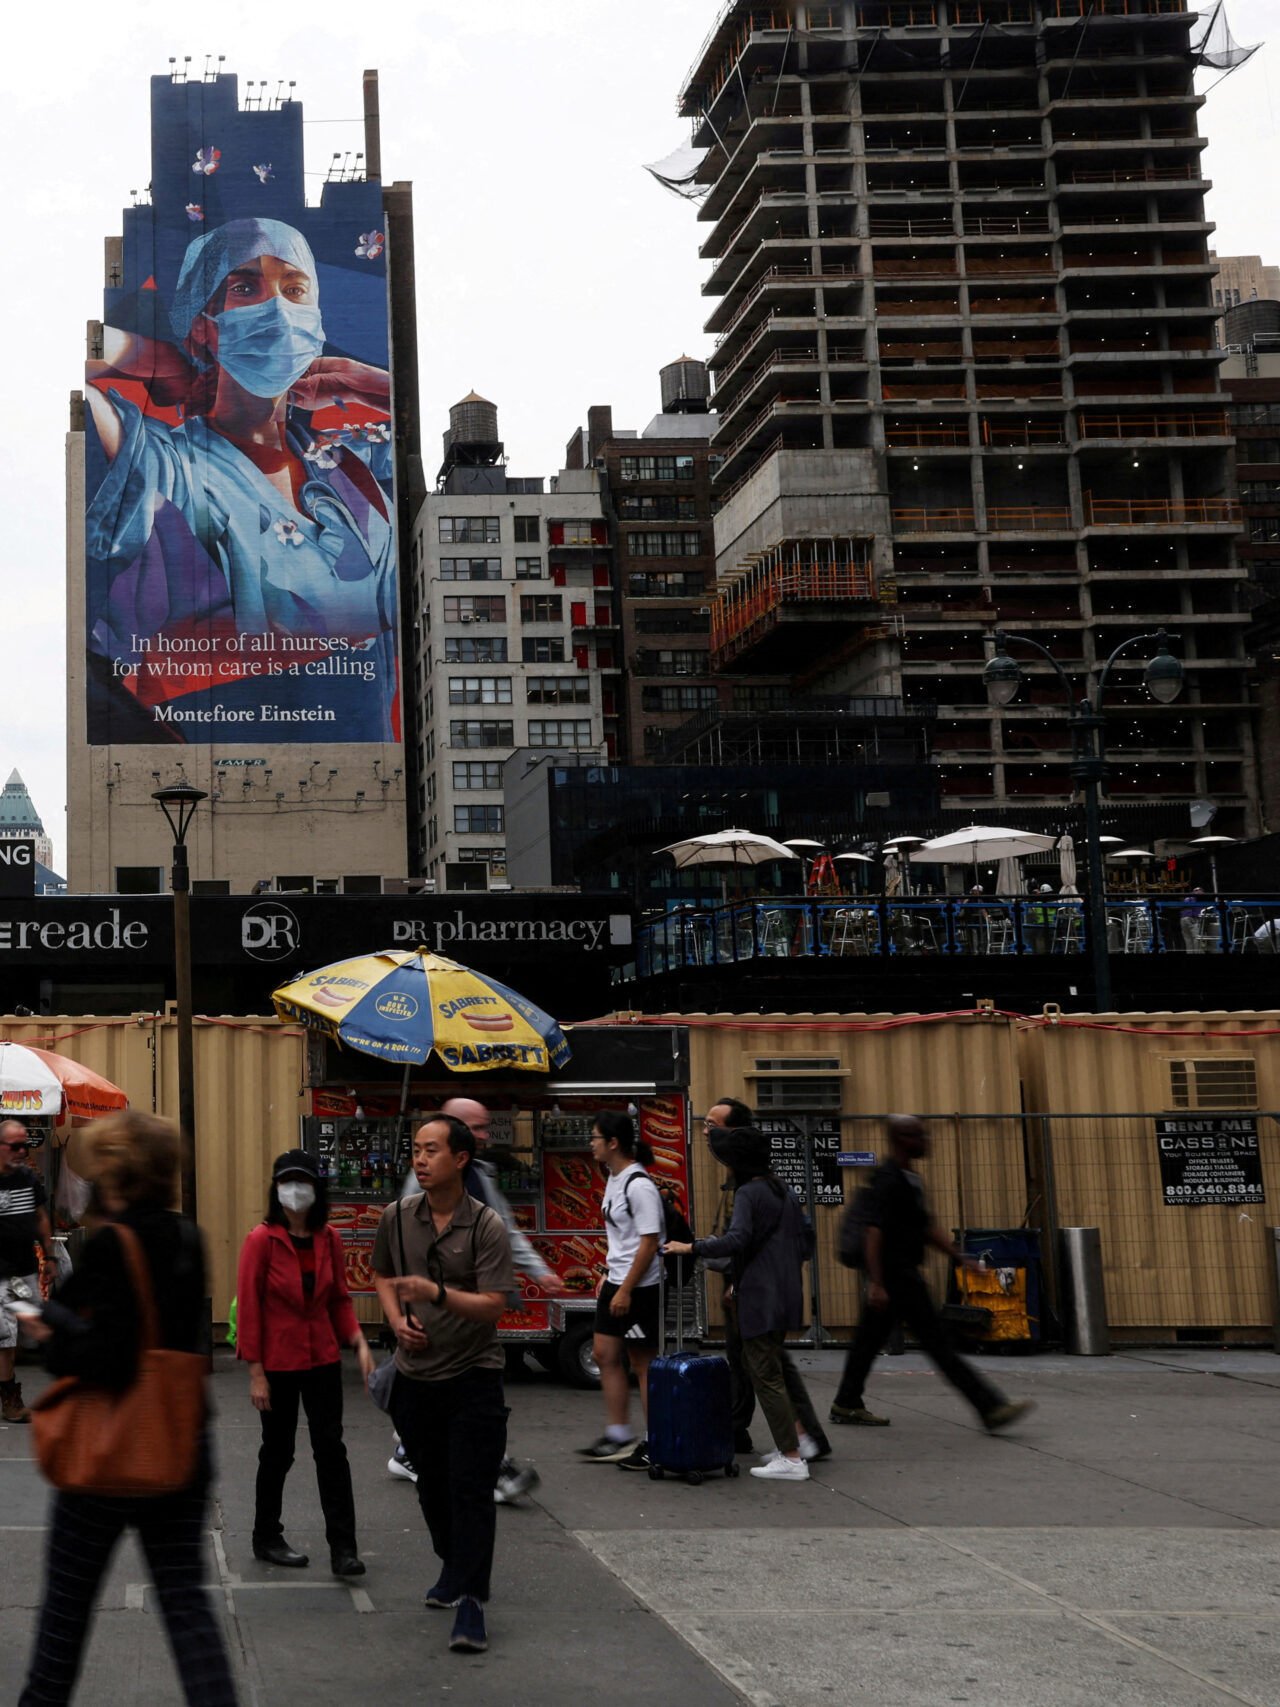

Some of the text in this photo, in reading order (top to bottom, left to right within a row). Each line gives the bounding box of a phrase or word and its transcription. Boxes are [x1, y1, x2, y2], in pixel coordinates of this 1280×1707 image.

[130, 633, 357, 654] In honor of all nurses,
[112, 656, 376, 681] for whom care is a calling
[153, 704, 337, 722] Montefiore Einstein
[393, 920, 430, 941] DR
[309, 975, 370, 990] SABRETT
[439, 996, 498, 1019] SABRETT
[391, 1044, 409, 1052] ROLL
[443, 1043, 545, 1066] SABRETT
[489, 1117, 512, 1126] ASH
[1164, 1119, 1252, 1132] RENT ME
[1166, 1184, 1262, 1195] 800.640.8844
